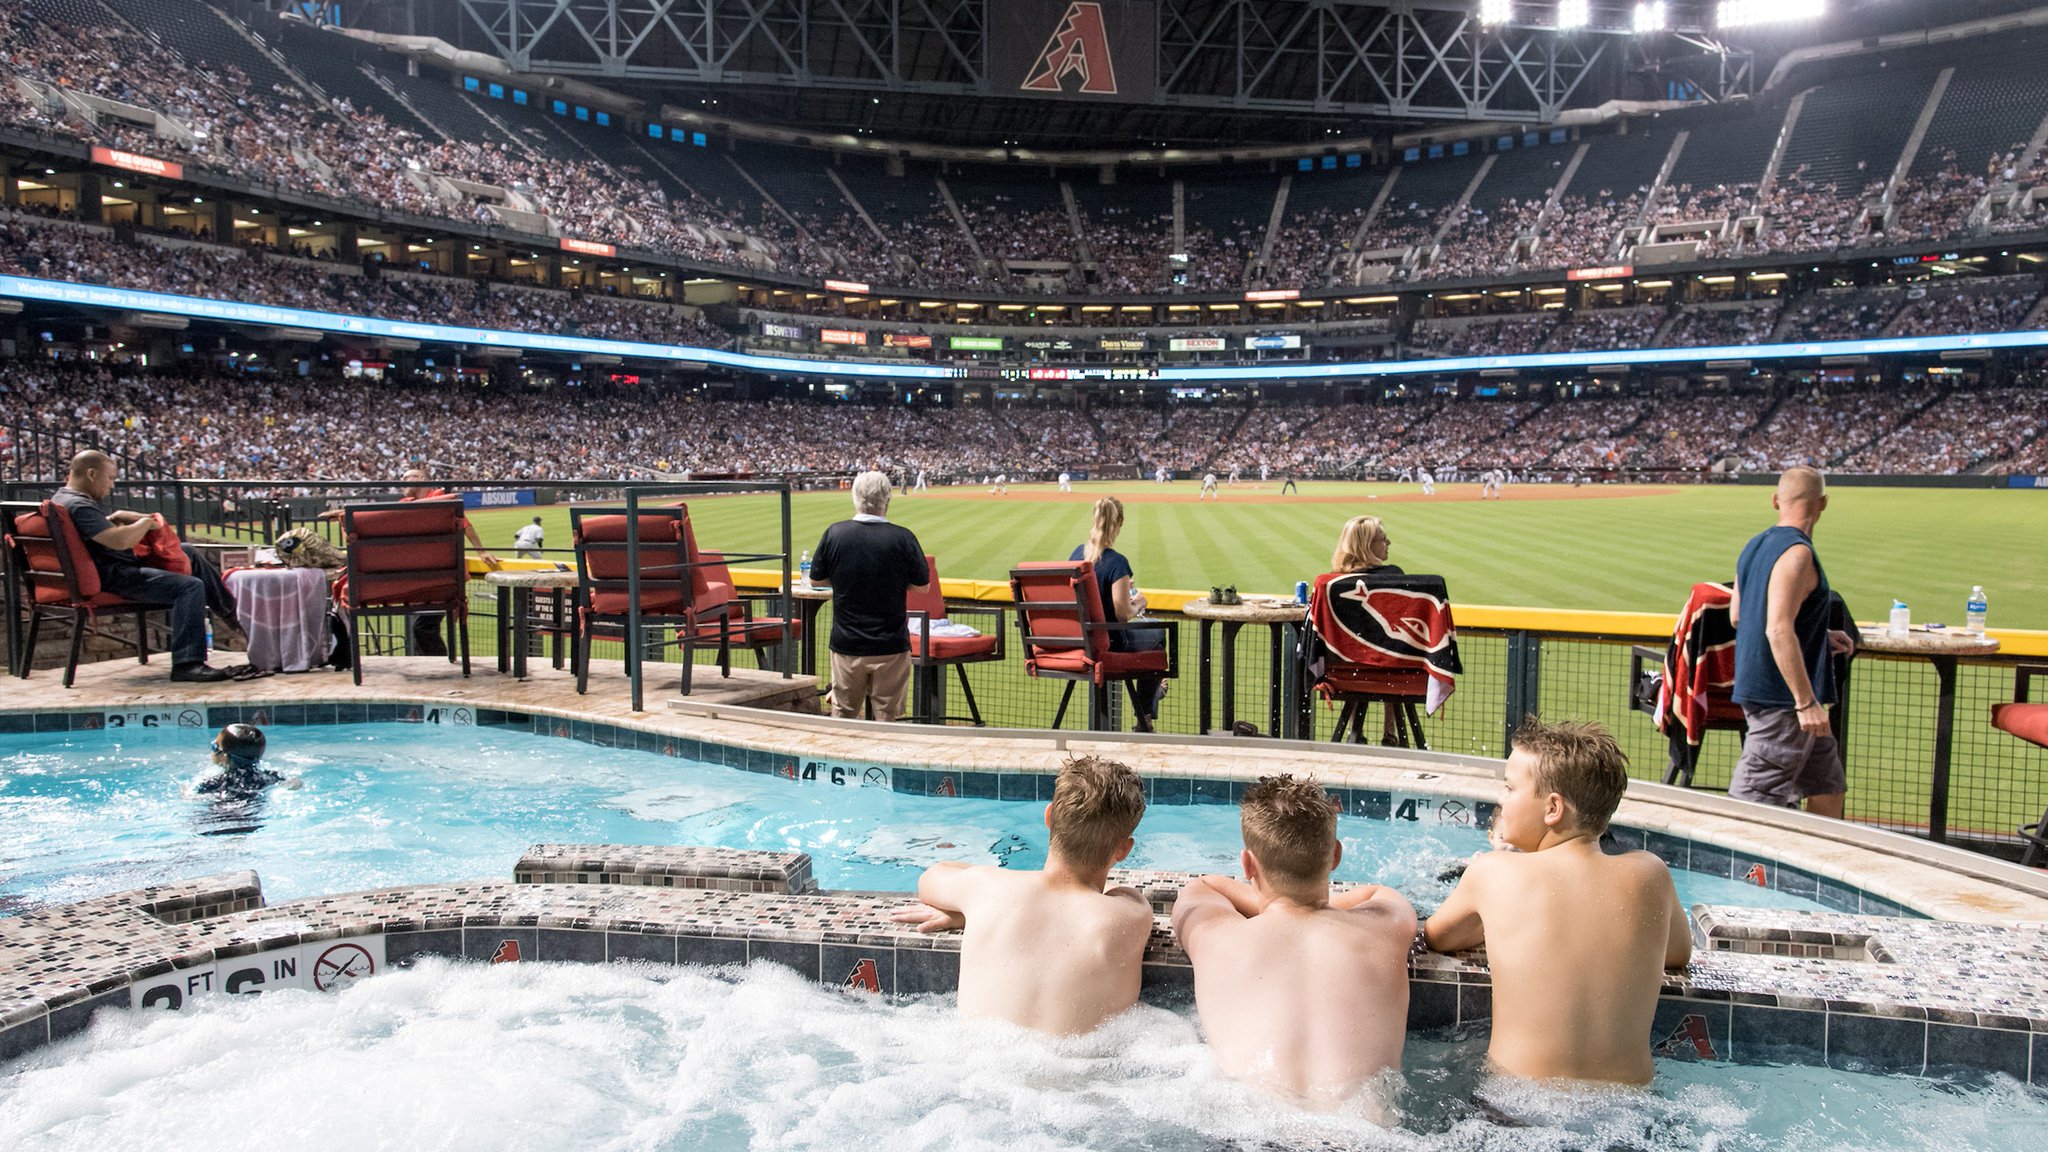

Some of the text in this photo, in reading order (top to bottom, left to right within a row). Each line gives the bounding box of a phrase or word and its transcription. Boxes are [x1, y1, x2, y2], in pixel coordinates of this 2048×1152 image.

[127, 713, 138, 721] FT
[161, 713, 171, 721] IN
[802, 761, 857, 787] 4 FT 6 IN
[1395, 798, 1432, 822] 4 FT
[188, 970, 214, 996] FT
[274, 957, 297, 980] IN
